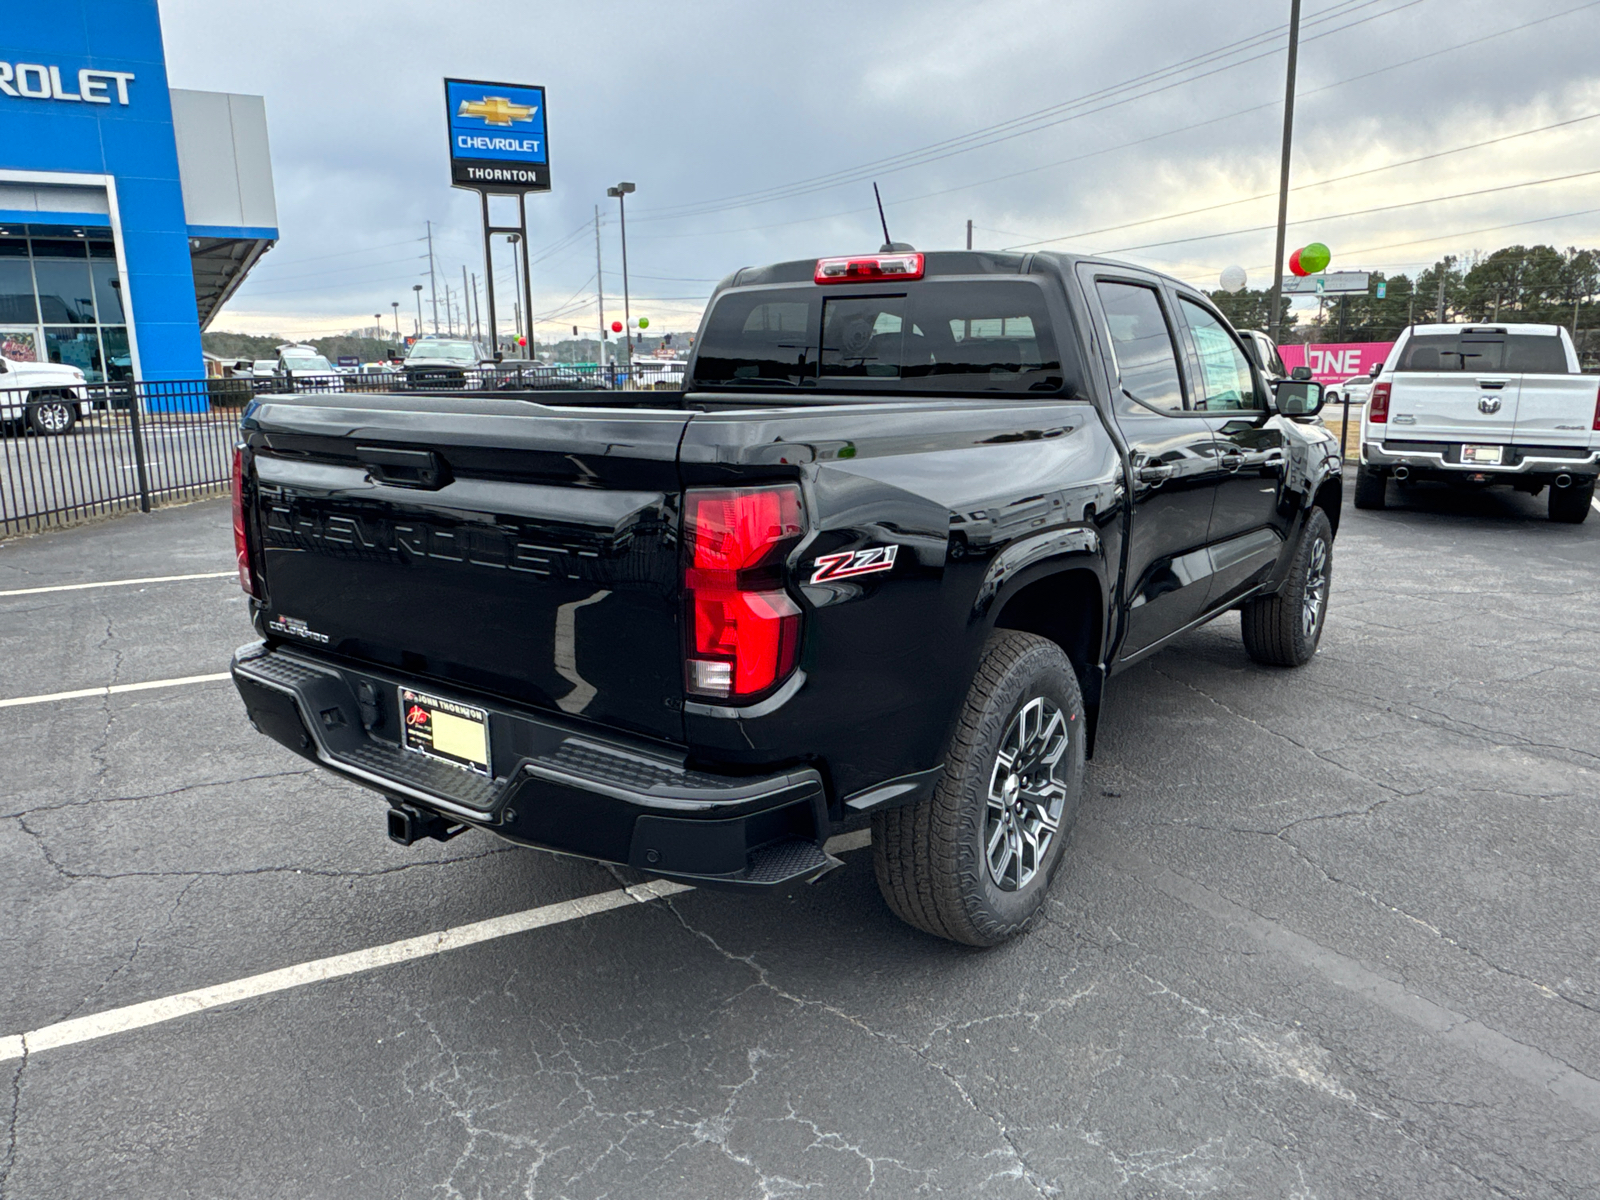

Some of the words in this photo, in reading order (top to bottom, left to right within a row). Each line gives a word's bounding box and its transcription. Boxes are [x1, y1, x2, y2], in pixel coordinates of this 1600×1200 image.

[0, 61, 135, 106] ROLET
[457, 135, 541, 153] CHEVROLET
[466, 167, 537, 182] THORNTON
[1309, 349, 1362, 374] ONE
[810, 544, 899, 585] Z71
[269, 620, 330, 643] COLORADO
[418, 694, 439, 708] JOHN
